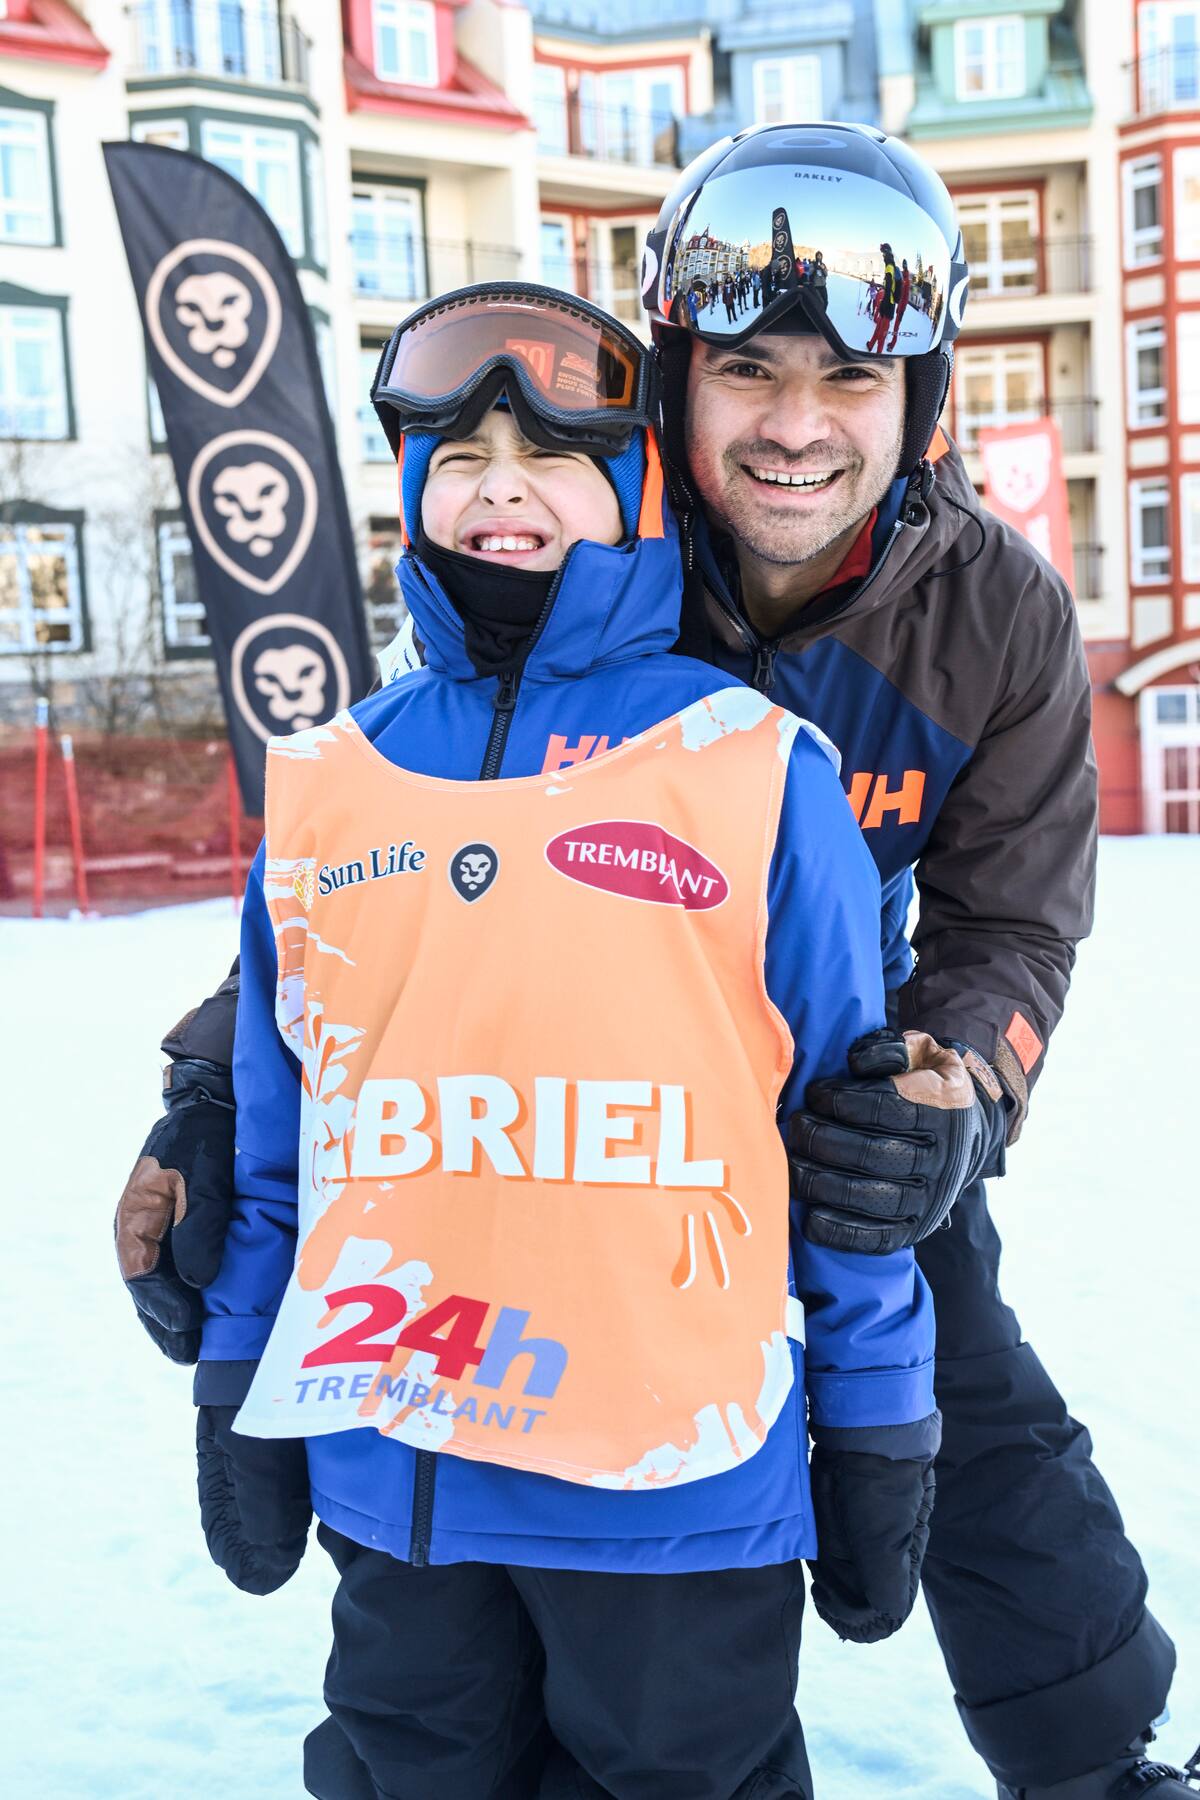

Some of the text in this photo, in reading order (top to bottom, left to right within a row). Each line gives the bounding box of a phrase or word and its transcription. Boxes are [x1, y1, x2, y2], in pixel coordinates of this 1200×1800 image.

[794, 172, 842, 183] OAKLEY
[541, 734, 632, 775] H
[318, 841, 425, 895] Sun Life
[564, 841, 719, 900] TREMBLANT
[300, 1283, 569, 1400] 24h
[294, 1373, 547, 1434] TREMBLANT
